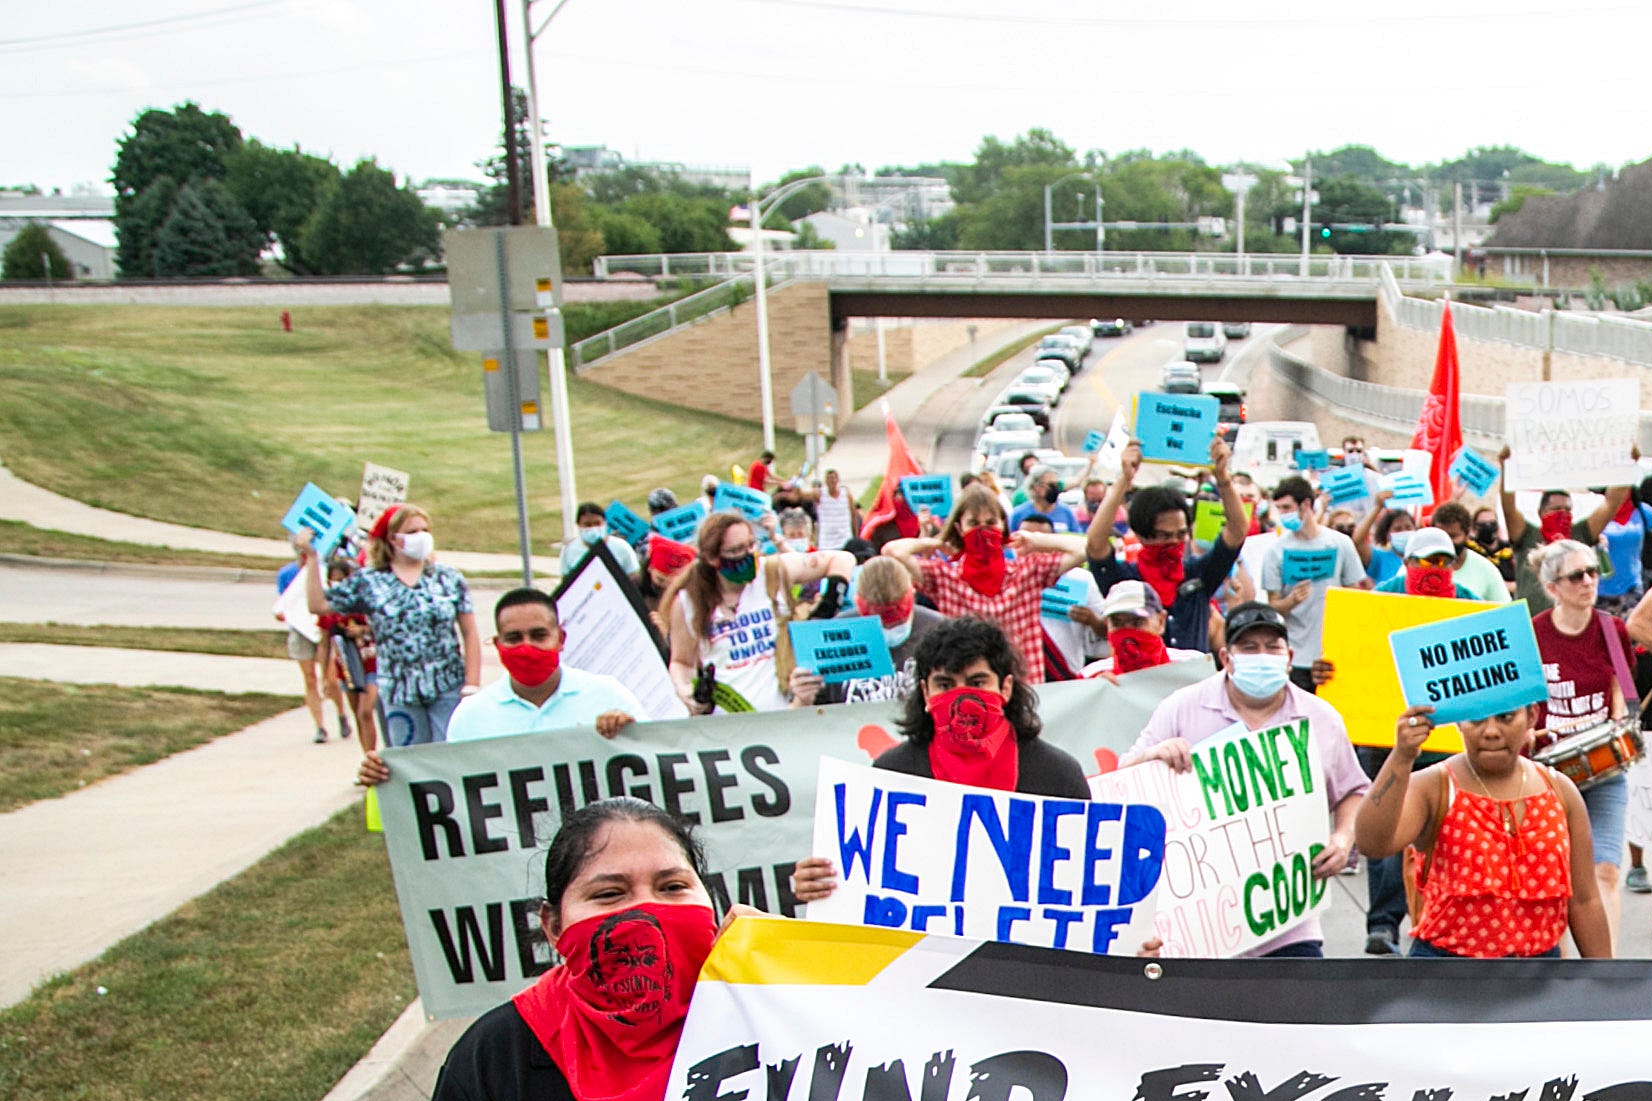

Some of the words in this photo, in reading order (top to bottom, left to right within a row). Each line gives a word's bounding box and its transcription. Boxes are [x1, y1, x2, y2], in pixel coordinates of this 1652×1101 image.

[729, 632, 748, 647] TO
[752, 627, 772, 640] BE
[814, 643, 868, 660] EXCLUDED
[1419, 643, 1448, 669] NO
[1450, 628, 1510, 662] MORE
[1426, 660, 1520, 702] STALLING
[1191, 718, 1313, 820] MONEY
[834, 781, 927, 895] WE
[950, 793, 1167, 906] NEED
[1164, 833, 1220, 899] OR
[1209, 804, 1295, 878] THE
[1243, 842, 1328, 936] GOOD
